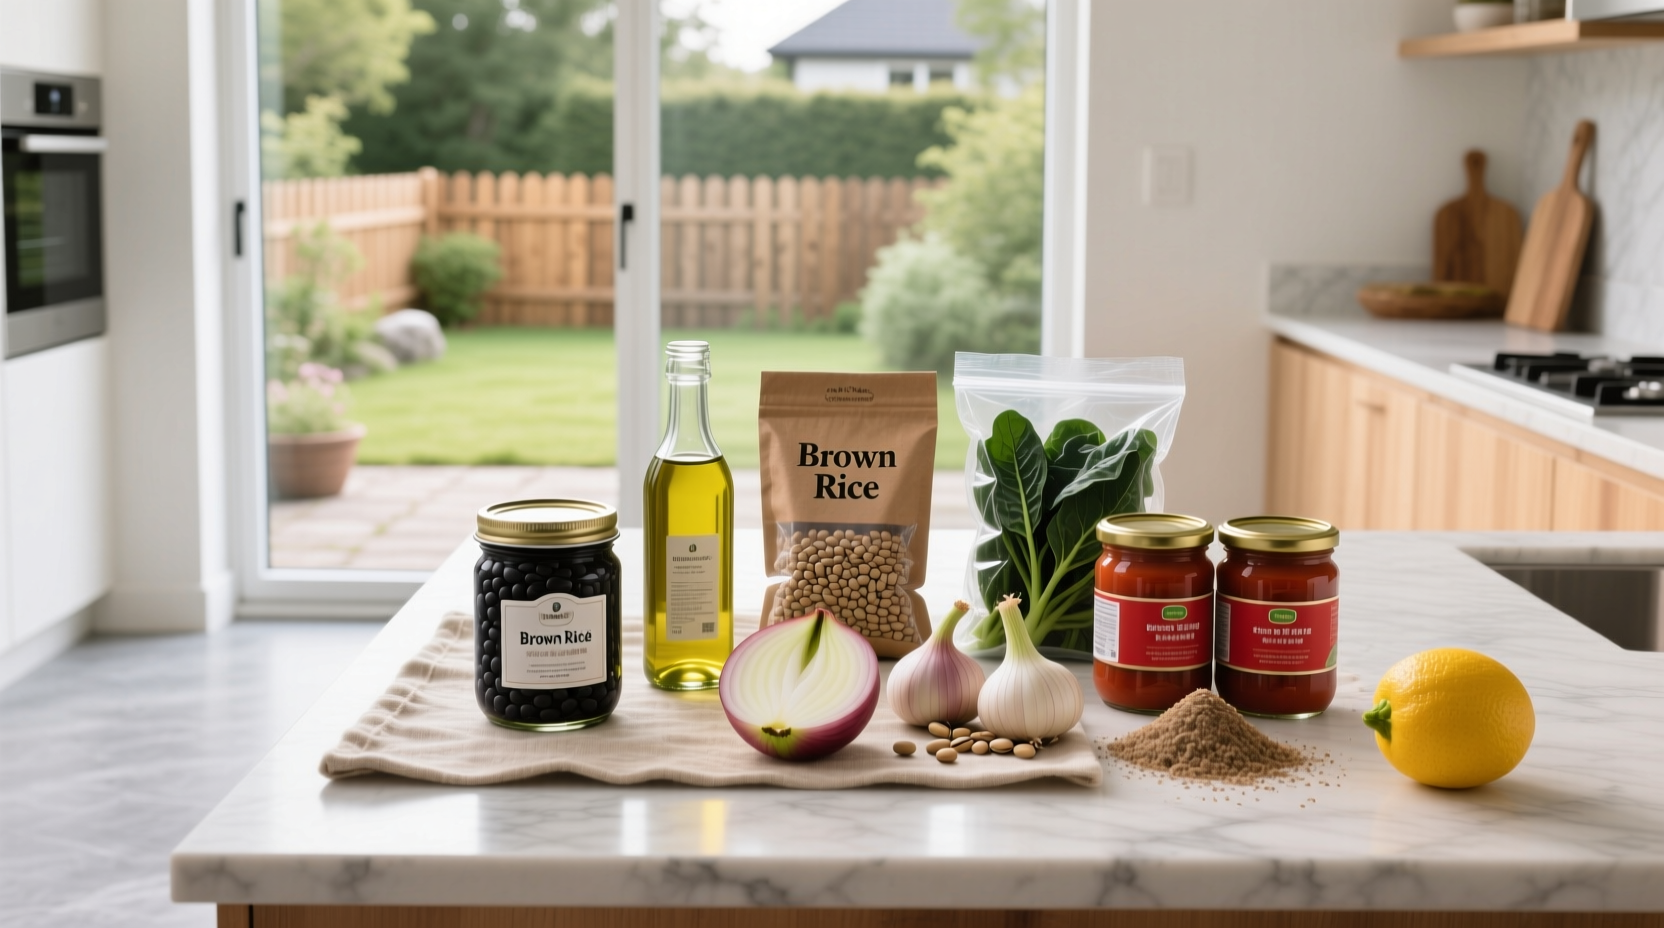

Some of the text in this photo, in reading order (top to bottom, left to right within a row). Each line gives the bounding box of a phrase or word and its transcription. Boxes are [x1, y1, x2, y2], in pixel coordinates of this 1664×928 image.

[797, 442, 897, 468] Brown
[813, 473, 879, 499] Rice
[520, 630, 592, 645] Brown Rice
